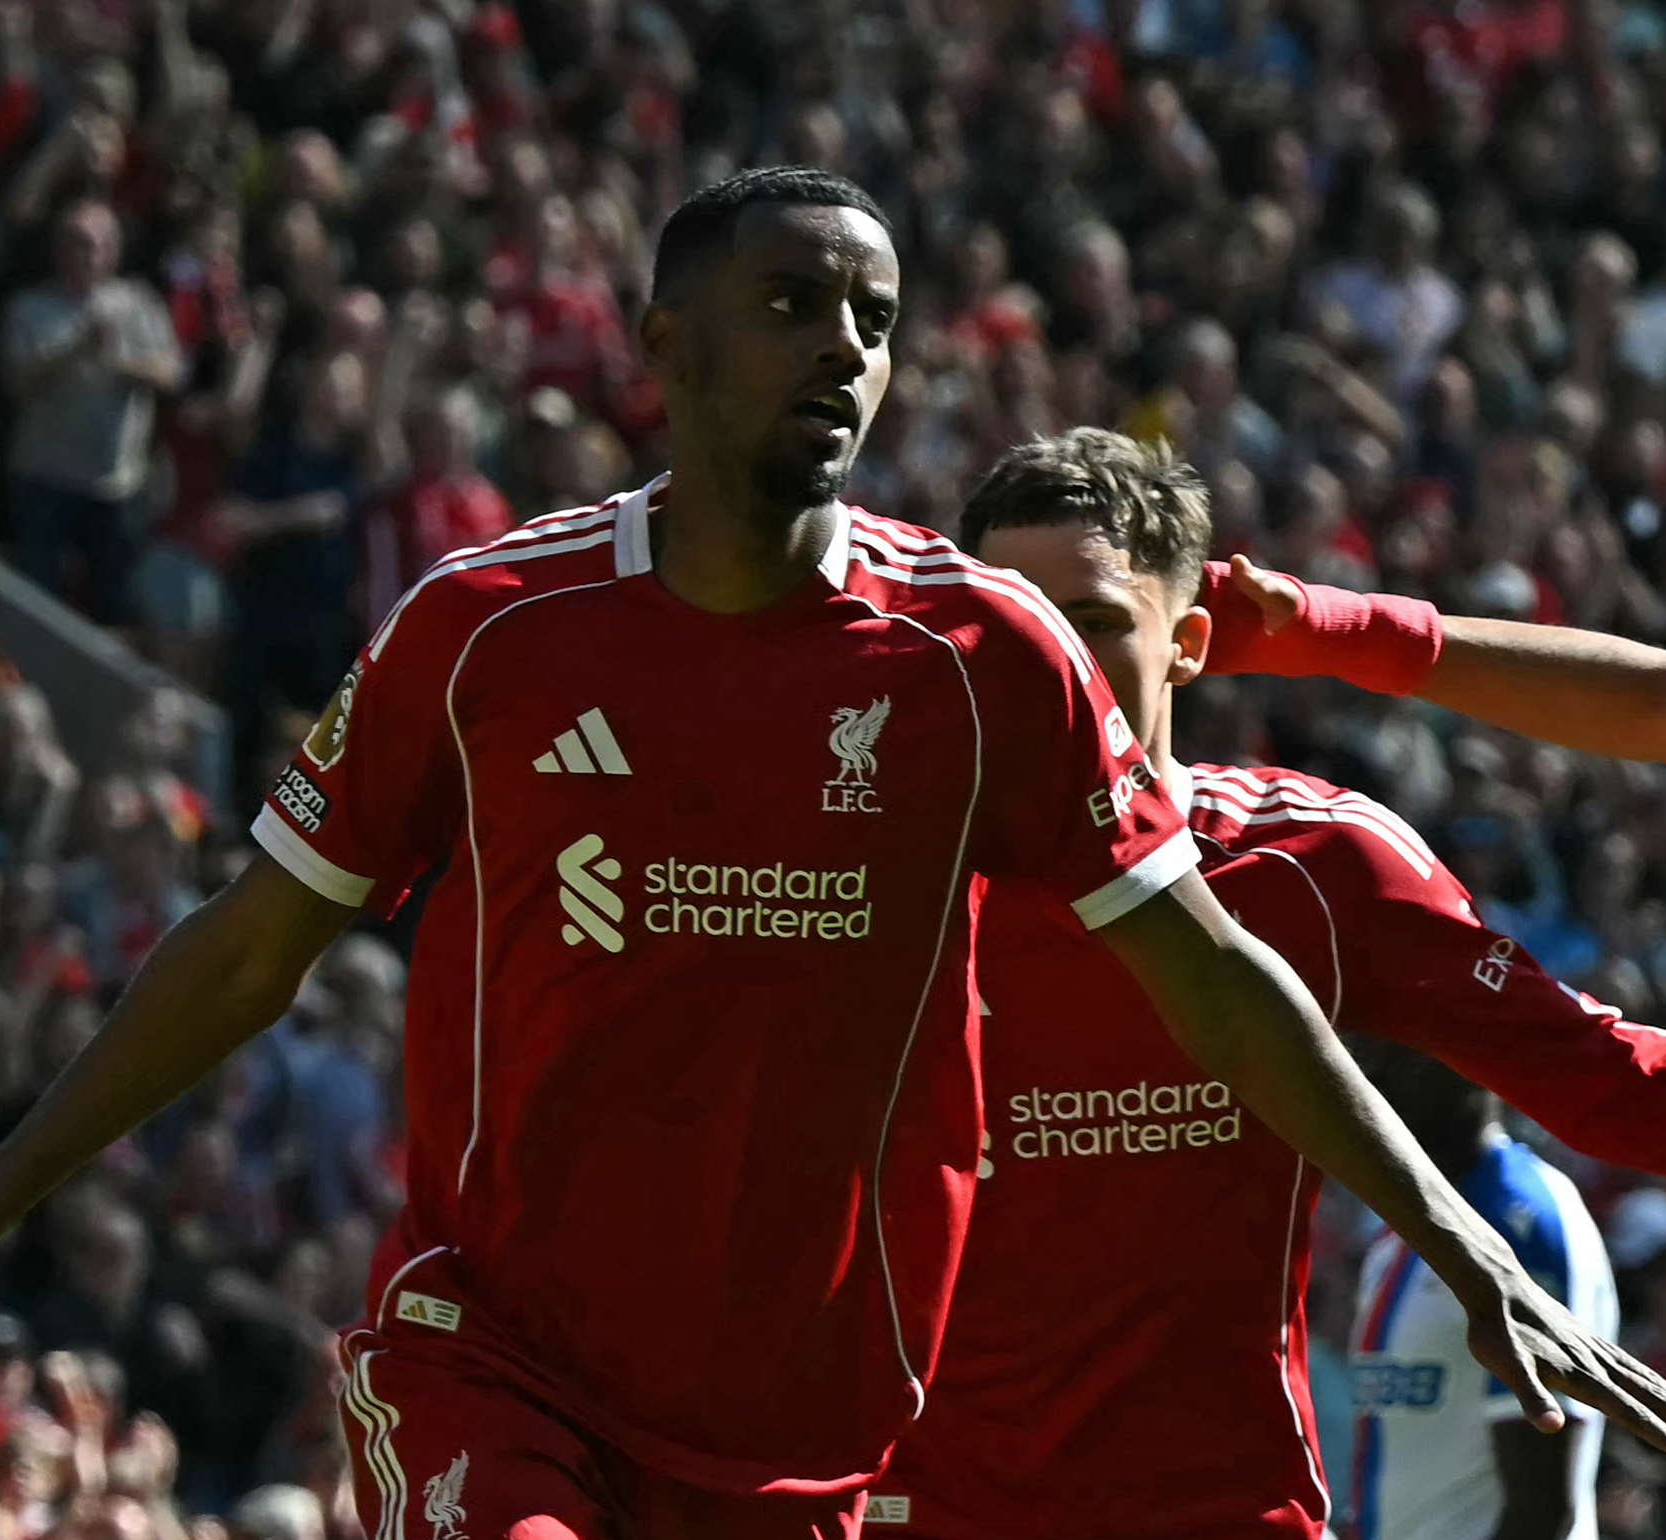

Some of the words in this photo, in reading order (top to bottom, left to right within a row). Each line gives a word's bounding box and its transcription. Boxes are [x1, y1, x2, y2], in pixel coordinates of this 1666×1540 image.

[821, 788, 882, 813] L.F.C.
[644, 857, 867, 900] standard
[644, 897, 872, 940] chartered
[1013, 1107, 1241, 1158] chartered
